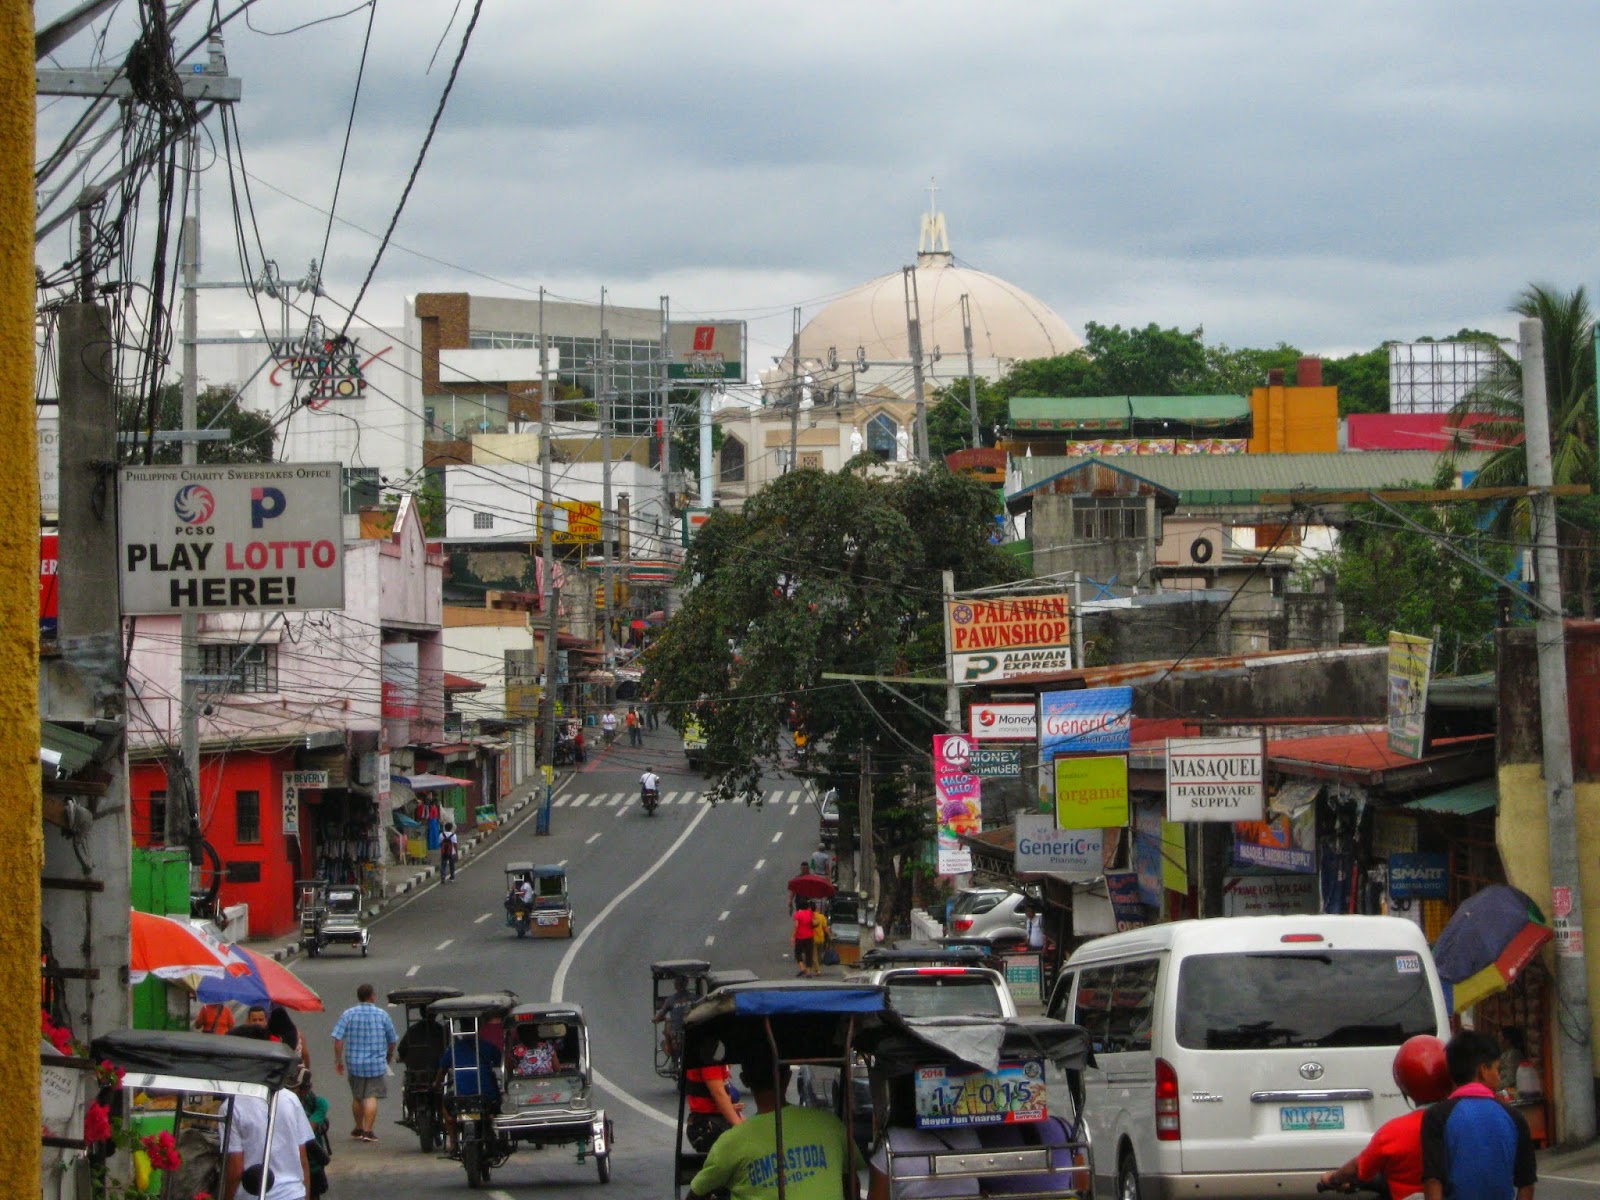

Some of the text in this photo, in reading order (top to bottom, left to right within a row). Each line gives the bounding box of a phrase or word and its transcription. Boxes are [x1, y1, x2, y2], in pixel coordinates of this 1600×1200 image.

[175, 526, 215, 535] PCSO
[127, 539, 336, 571] PLAY LOTTO
[170, 577, 296, 606] HERE!
[972, 598, 1065, 624] PALAWAN
[955, 621, 1066, 649] PAWNSHOP
[1003, 659, 1067, 671] EXPRESS
[969, 751, 1018, 763] MONEY
[970, 763, 1019, 774] CHANGER
[1171, 759, 1260, 780] MASAQUEL
[294, 773, 326, 783] BEVERLY
[1059, 783, 1125, 804] organic
[1177, 786, 1255, 796] HARDWARE
[1191, 797, 1241, 808] SUPPLY
[1050, 856, 1088, 864] Pharmacy
[1391, 868, 1445, 880] SMART
[921, 1069, 943, 1078] 2014
[934, 1081, 1032, 1107] 17-015
[921, 1117, 951, 1126] Mayor
[970, 1114, 1002, 1123] Ynares
